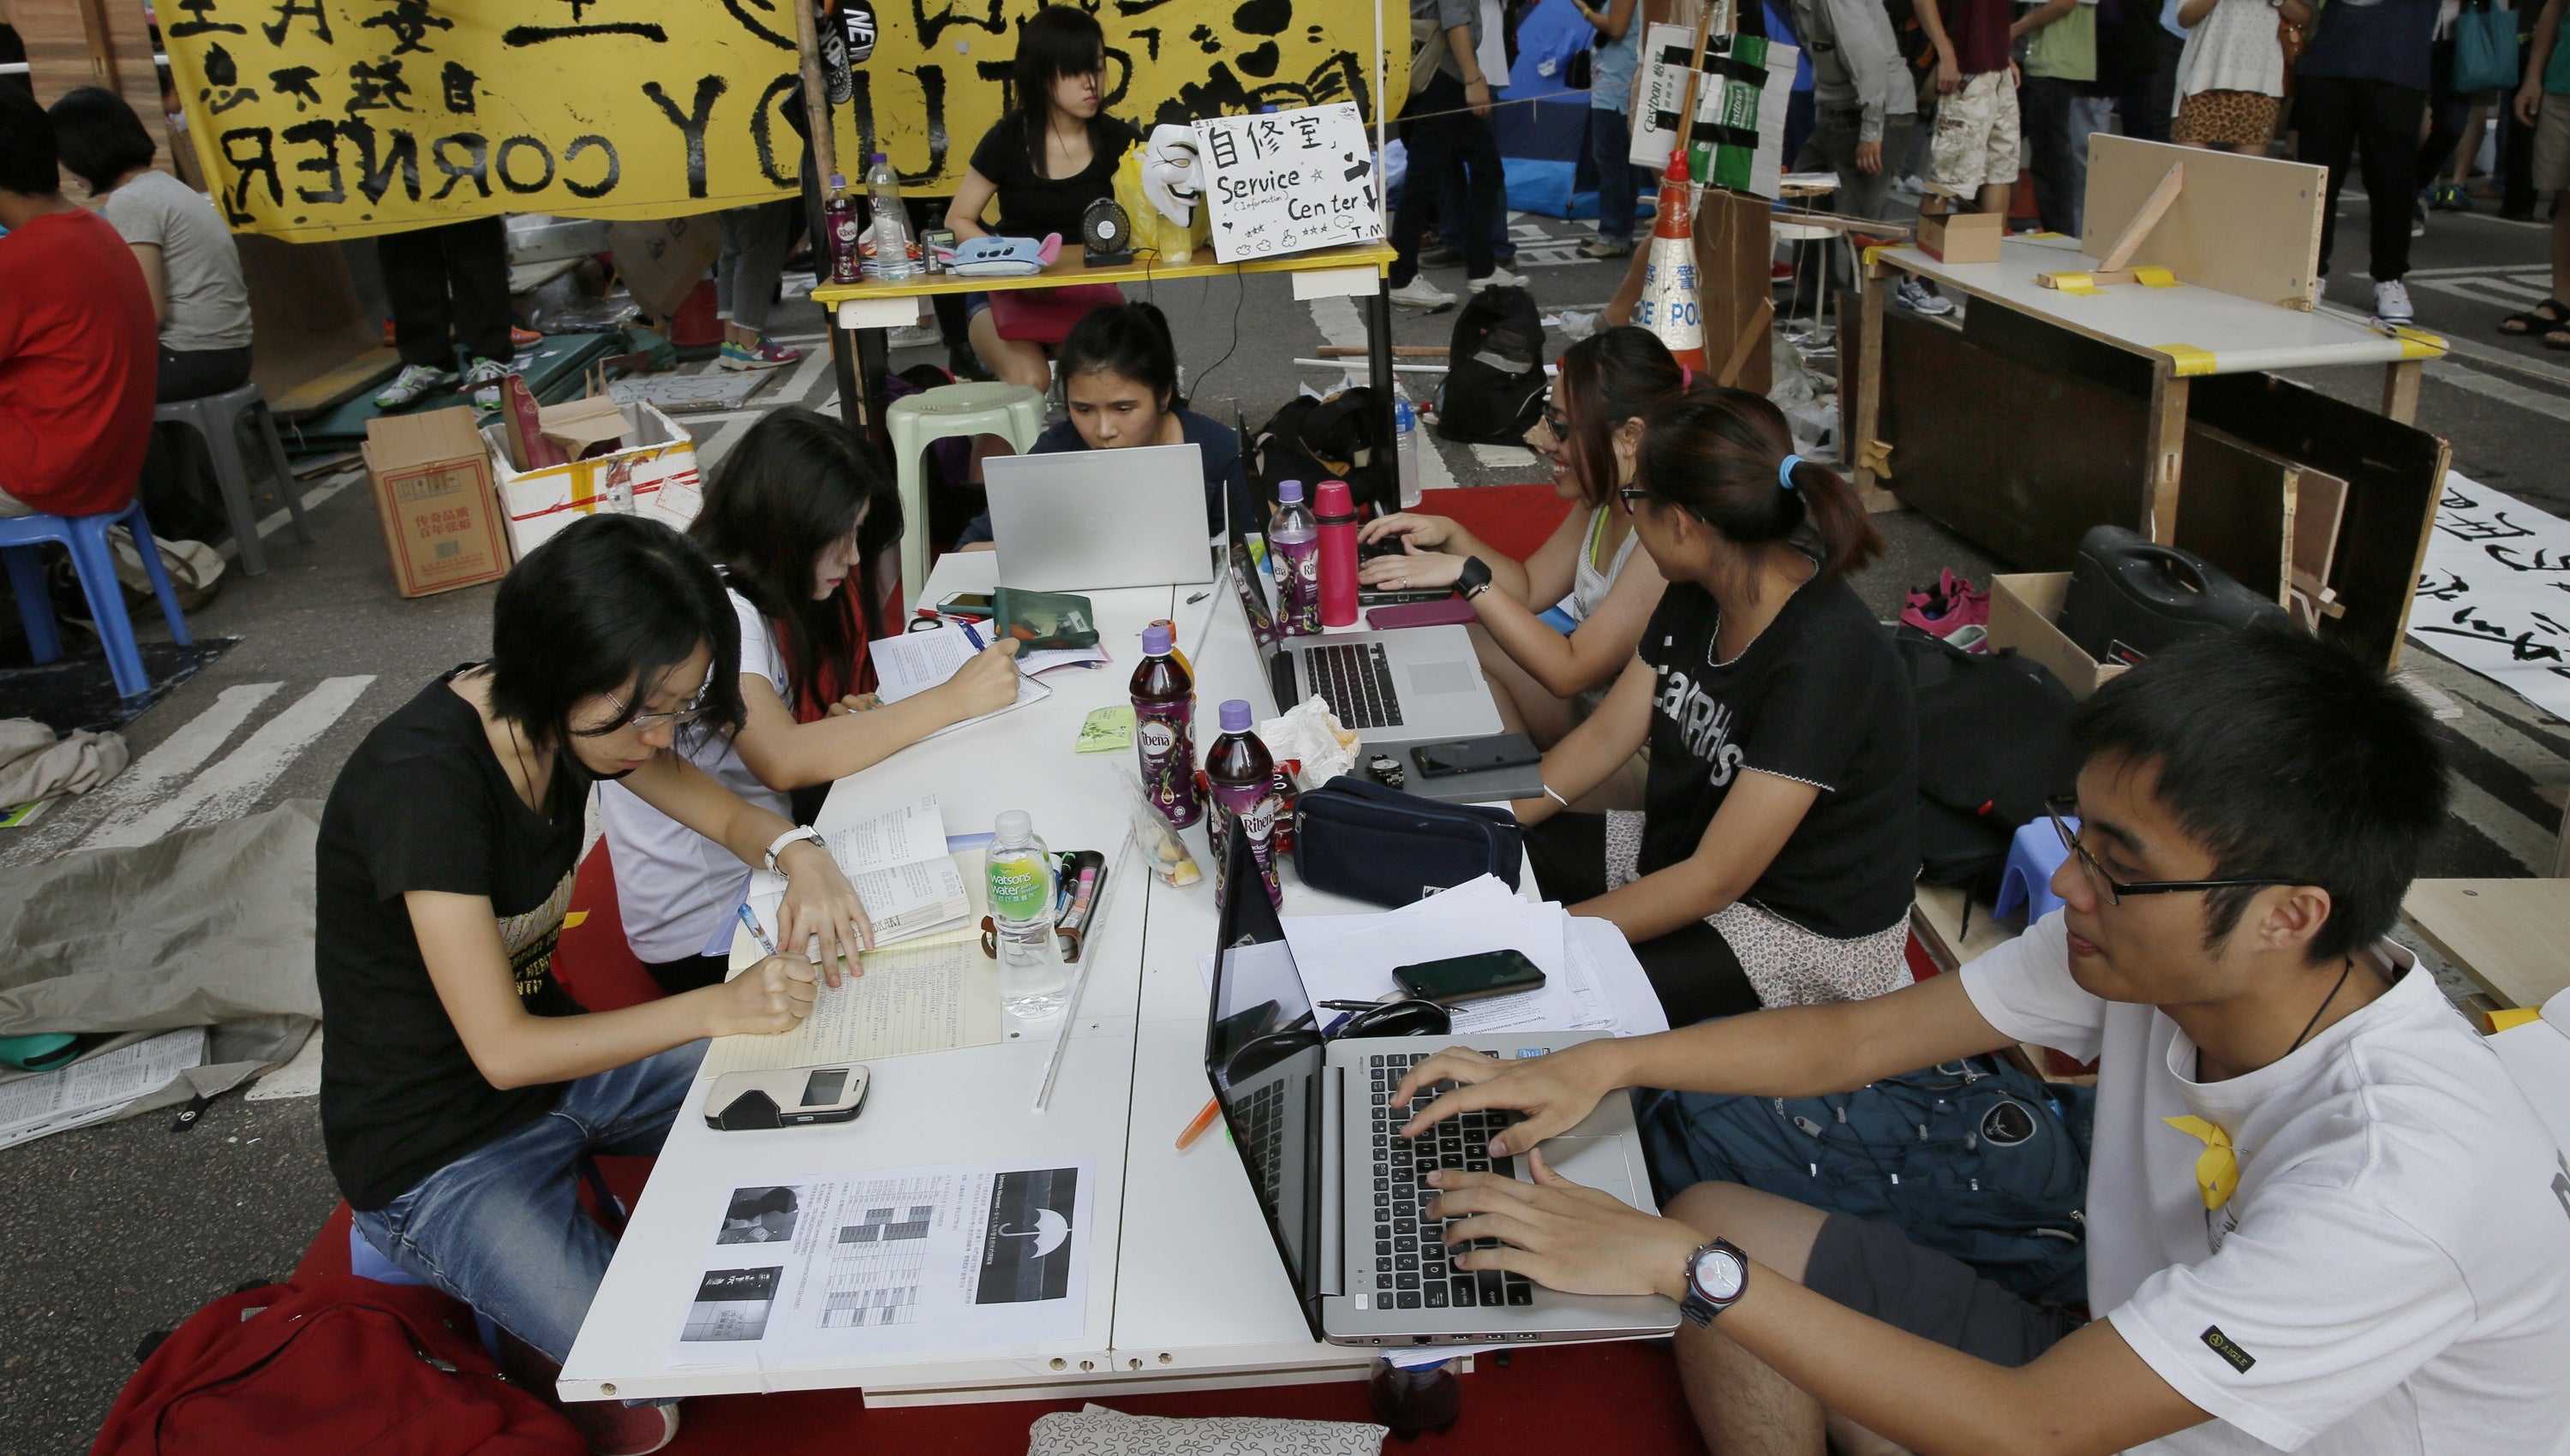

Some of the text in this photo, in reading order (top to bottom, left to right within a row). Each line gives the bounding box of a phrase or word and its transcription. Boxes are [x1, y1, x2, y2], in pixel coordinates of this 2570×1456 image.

[1644, 81, 1663, 133] Cestbon
[1731, 89, 1746, 126] estbon
[1217, 170, 1300, 205] Service
[2221, 1345, 2248, 1367] AIGLE
